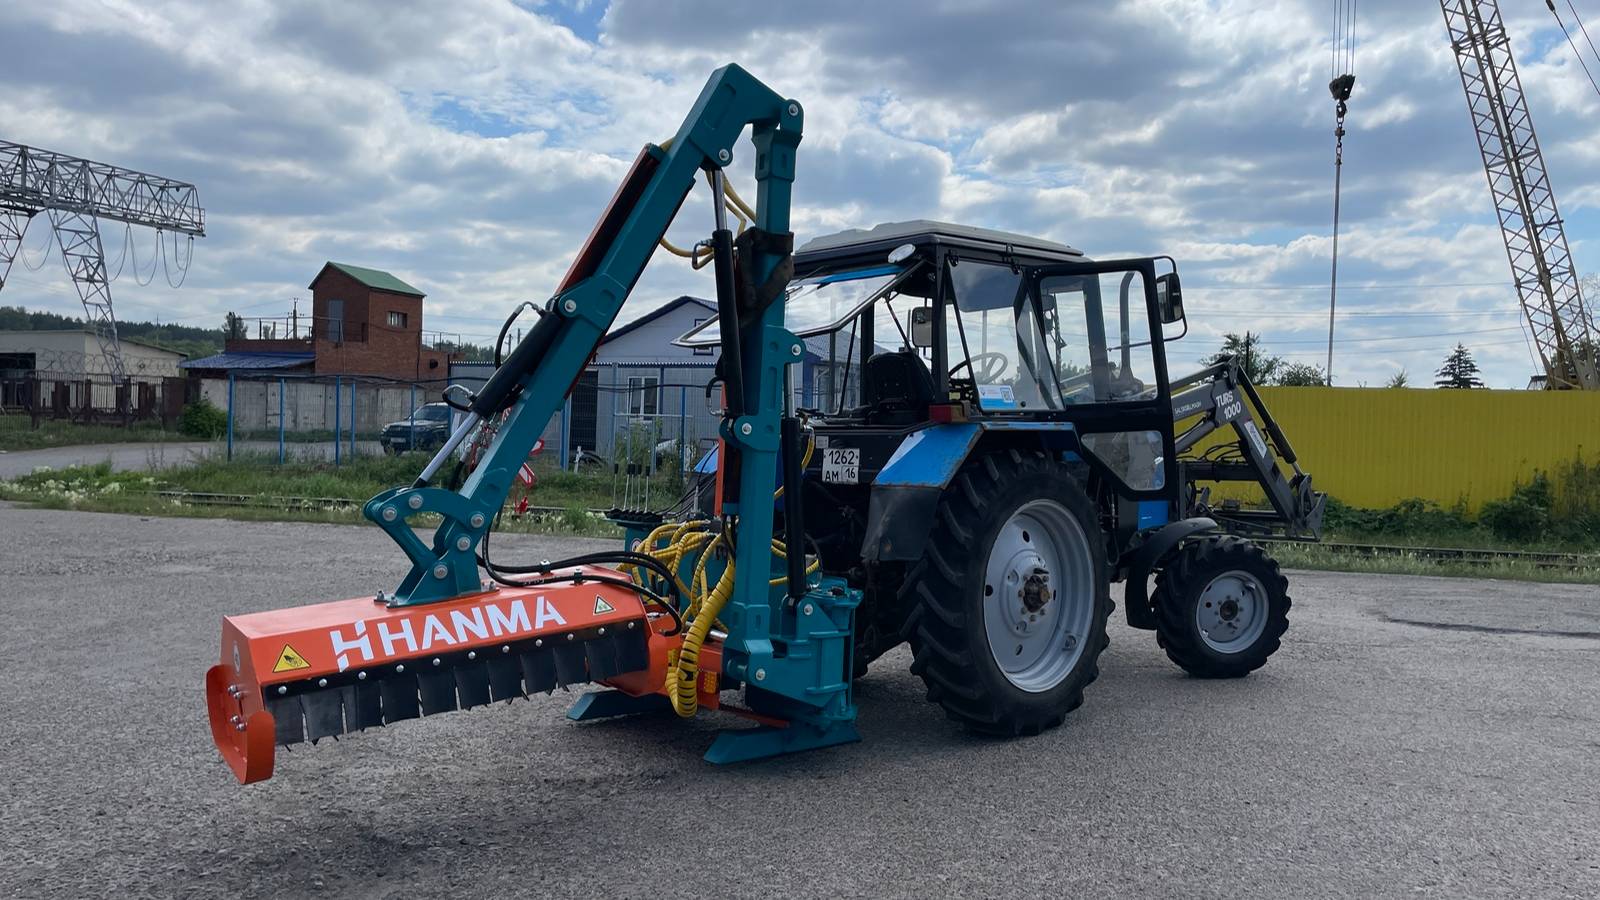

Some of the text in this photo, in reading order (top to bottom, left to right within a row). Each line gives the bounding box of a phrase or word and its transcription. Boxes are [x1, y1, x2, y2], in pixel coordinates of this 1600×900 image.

[1216, 391, 1234, 407] TURS
[1224, 401, 1242, 420] 1000
[828, 450, 855, 465] 1262
[845, 468, 856, 479] 16
[377, 595, 568, 657] HANMA
